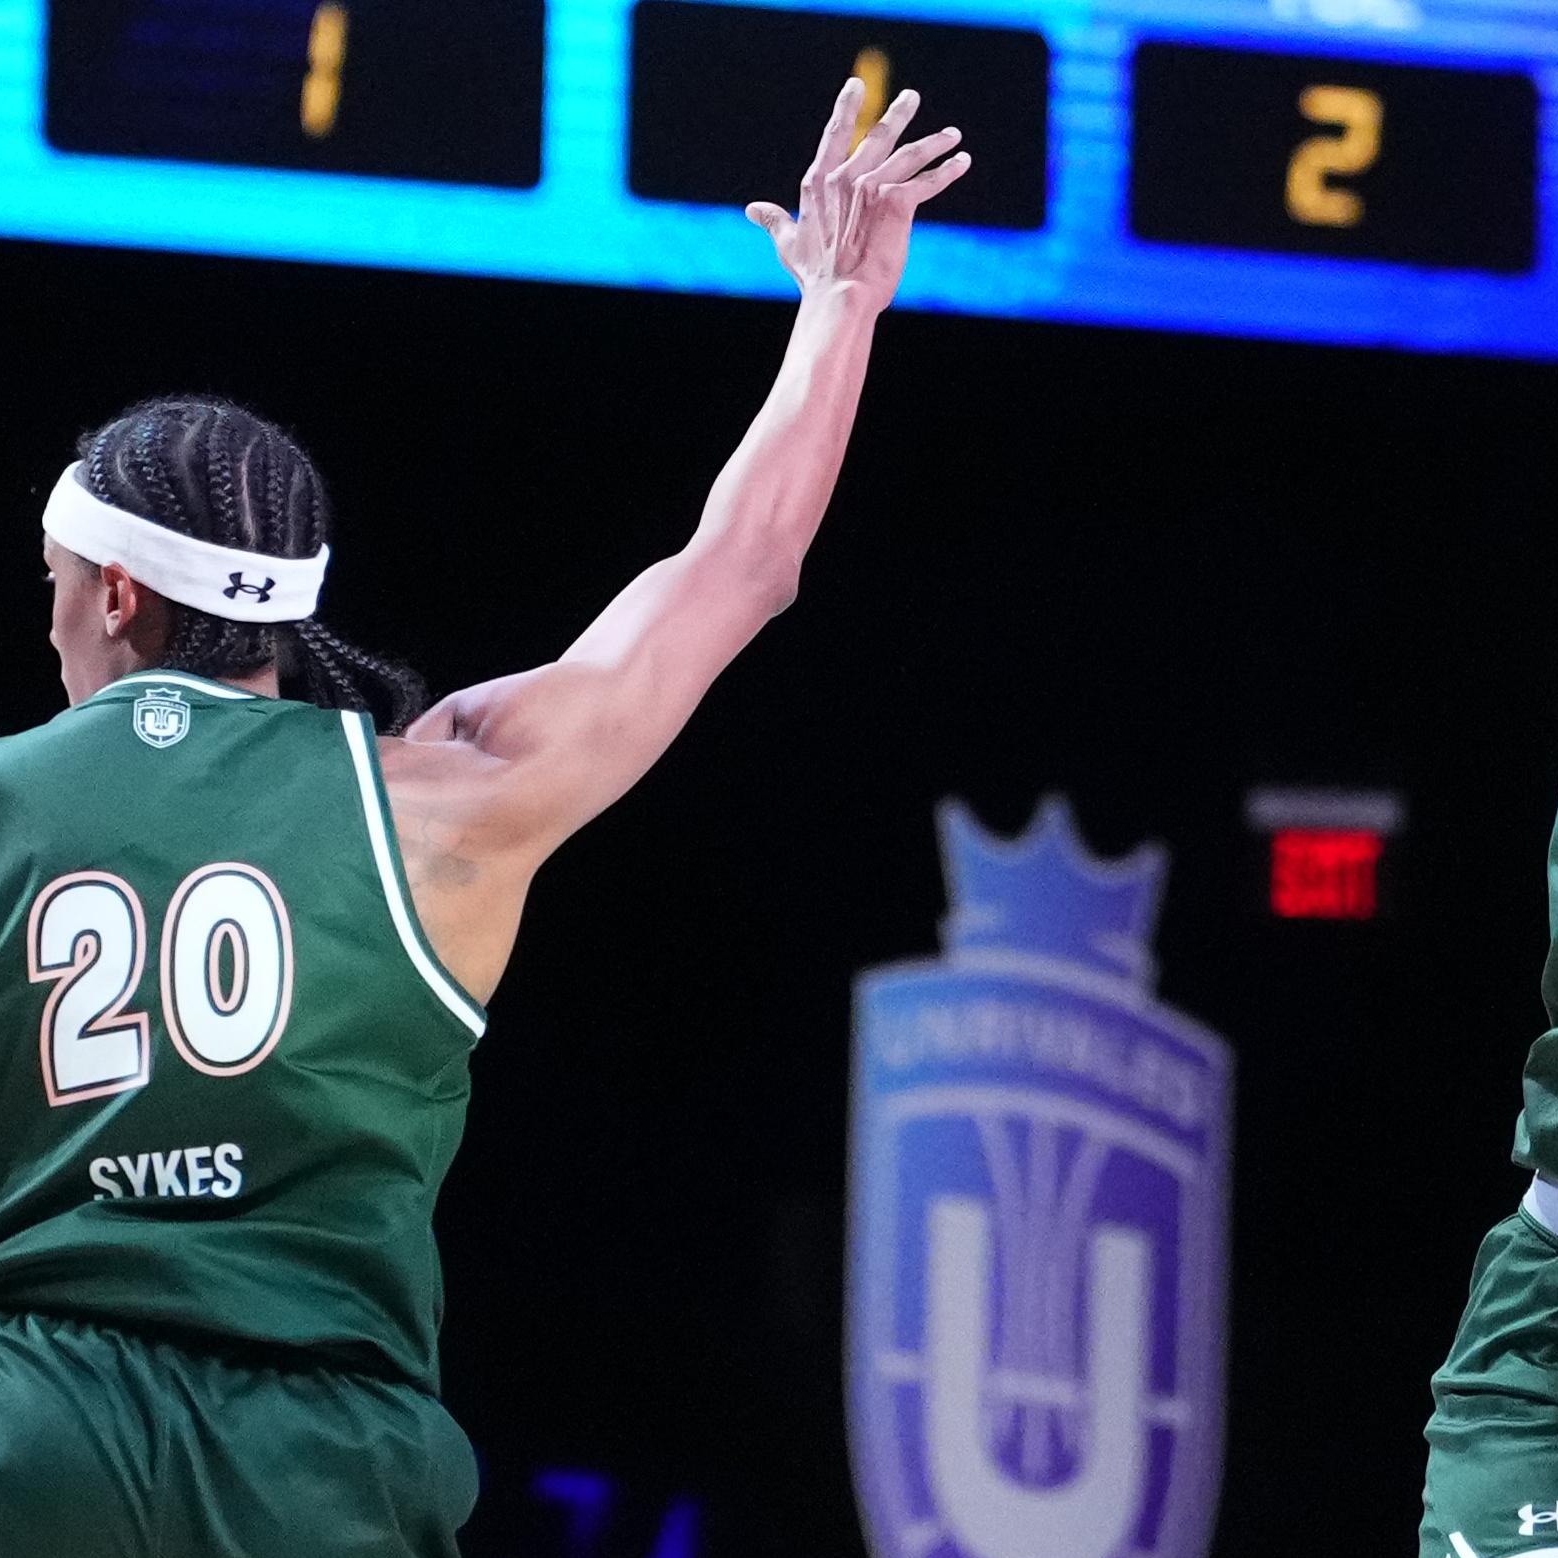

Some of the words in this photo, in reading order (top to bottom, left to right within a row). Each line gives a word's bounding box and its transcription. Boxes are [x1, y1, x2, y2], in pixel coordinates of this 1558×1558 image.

[1285, 84, 1384, 229] 2
[28, 863, 294, 1107] 20
[89, 1142, 243, 1201] SYKES
